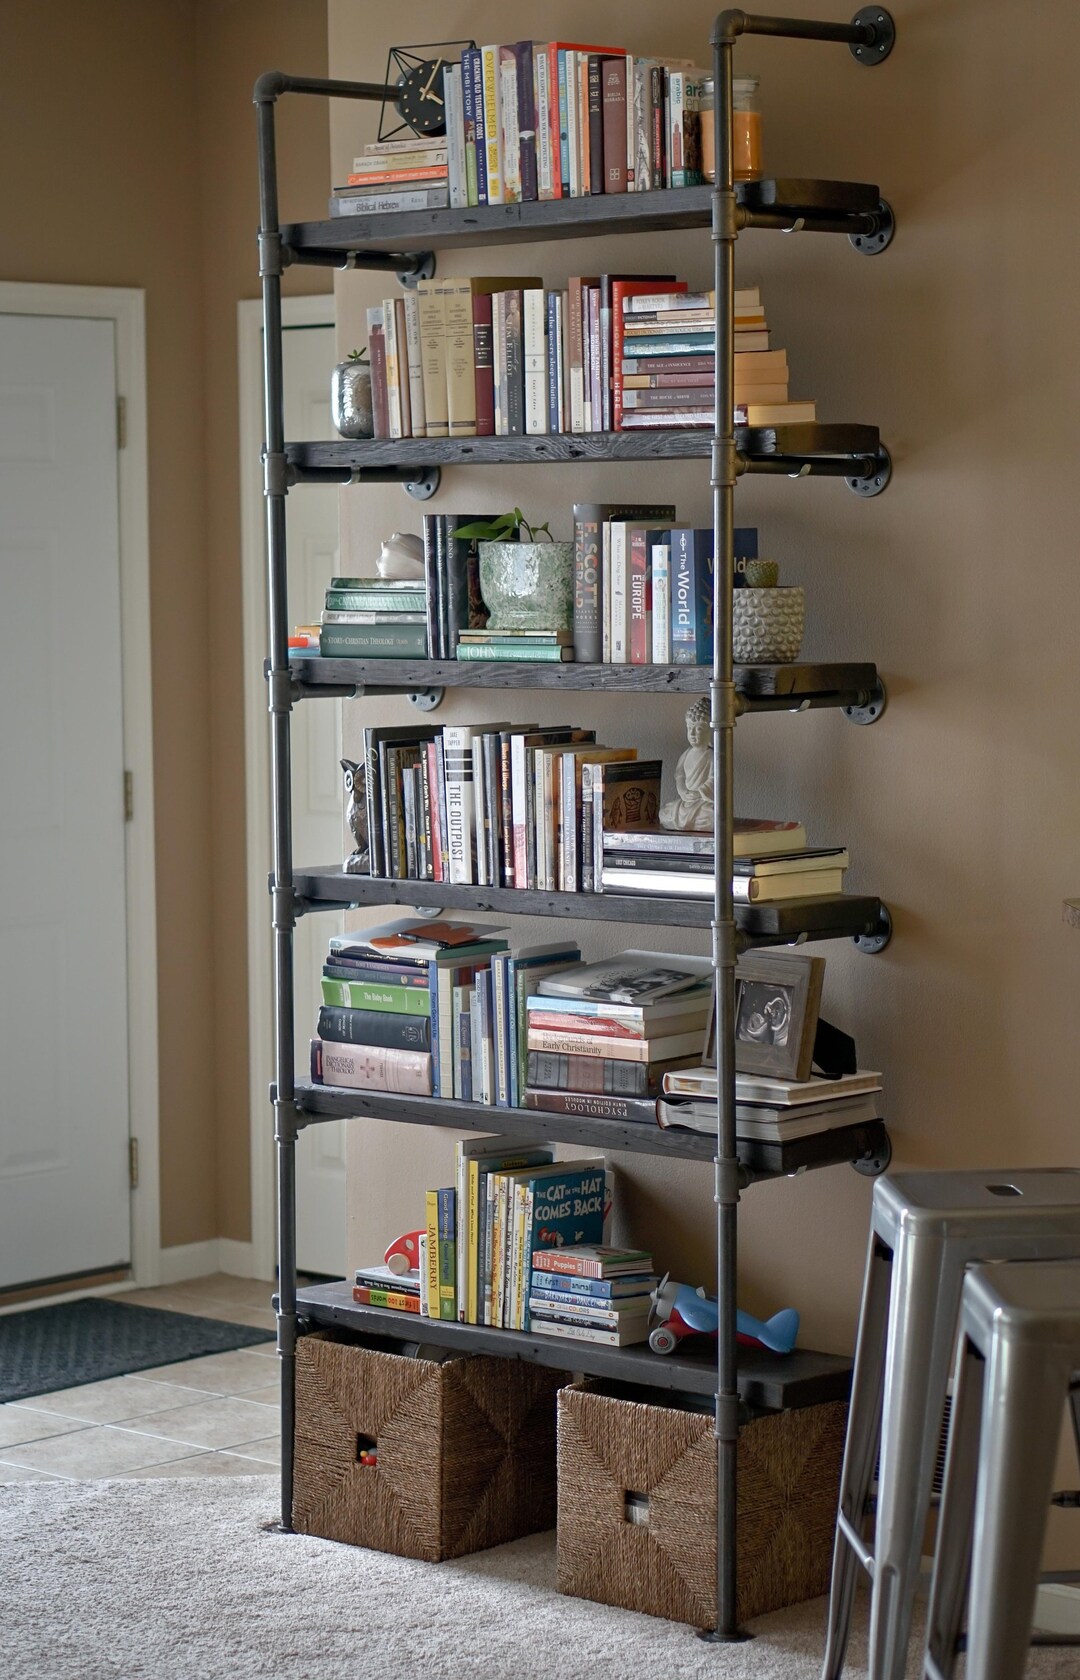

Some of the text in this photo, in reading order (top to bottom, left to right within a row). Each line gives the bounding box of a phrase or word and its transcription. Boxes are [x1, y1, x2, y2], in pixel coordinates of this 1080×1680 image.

[473, 58, 481, 82] CRACKING
[485, 51, 497, 138] OVERWHELMED
[475, 94, 483, 123] TESTAMENT
[476, 123, 484, 140] CODES
[356, 201, 400, 212] Biblical Hebrew
[411, 297, 416, 305] ON
[614, 352, 620, 364] TO
[614, 366, 620, 379] BE
[575, 522, 584, 608] FITZGERALD
[584, 522, 598, 608] F. SCOTT
[632, 574, 642, 620] EUROPE
[677, 570, 690, 624] World
[345, 637, 369, 645] CHRISTIAN
[370, 637, 394, 645] THEOLOGY
[467, 646, 496, 660] JOHN
[366, 747, 378, 800] Galatians
[450, 785, 463, 863] THE OUTPOST
[363, 992, 393, 1003] The Baby Book
[510, 1021, 515, 1029] Oz
[432, 1029, 437, 1038] Us
[542, 1041, 602, 1056] Early Christianity
[326, 1055, 354, 1064] EVANGELICAL
[326, 1060, 354, 1069] DICTIONARY
[331, 1066, 355, 1074] THEOLOGY
[565, 1103, 628, 1117] PSYCHOLOGY
[536, 1191, 546, 1199] THE
[546, 1184, 566, 1202] CAT
[581, 1177, 602, 1195] HAT
[535, 1197, 602, 1221] COMES BACK
[428, 1224, 437, 1290] JAMBERRY
[553, 1260, 576, 1270] Puppies
[545, 1277, 593, 1292] first animals
[371, 1294, 387, 1302] words
[388, 1297, 398, 1306] 100
[568, 1306, 590, 1314] COLORS
